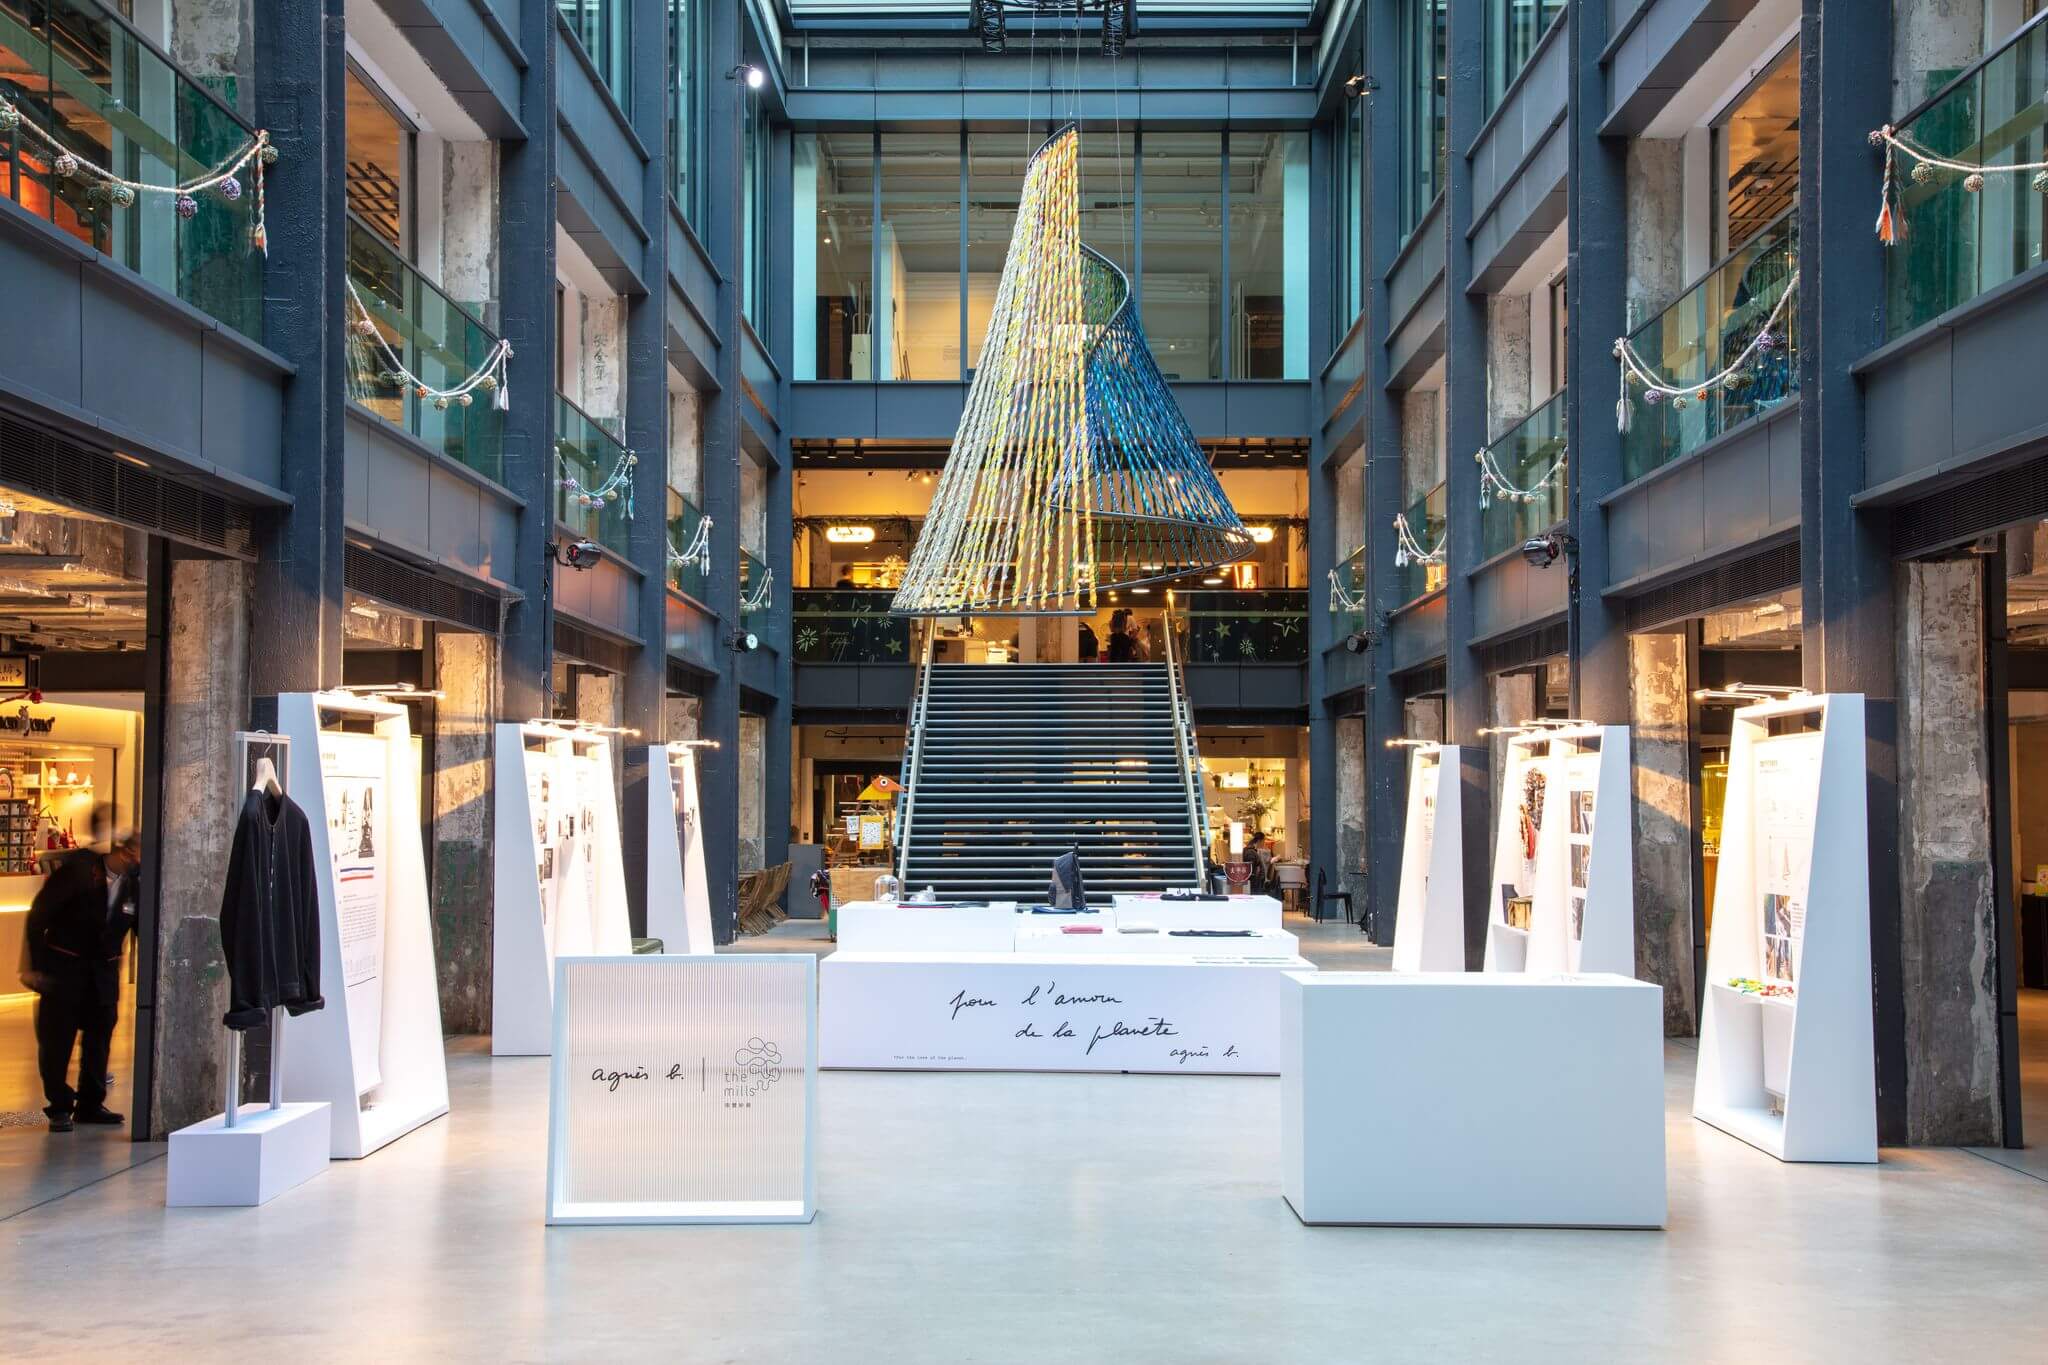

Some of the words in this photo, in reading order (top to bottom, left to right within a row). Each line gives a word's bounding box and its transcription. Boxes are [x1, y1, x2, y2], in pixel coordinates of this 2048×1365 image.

[950, 989, 997, 1020] pour
[1022, 981, 1122, 1005] l'amour
[1015, 1023, 1042, 1038] de
[1052, 1022, 1077, 1038] la
[1222, 1045, 1239, 1058] b.
[591, 1066, 649, 1092] agnès
[665, 1063, 685, 1080] b.
[724, 1073, 748, 1083] the
[723, 1085, 756, 1097] mills
